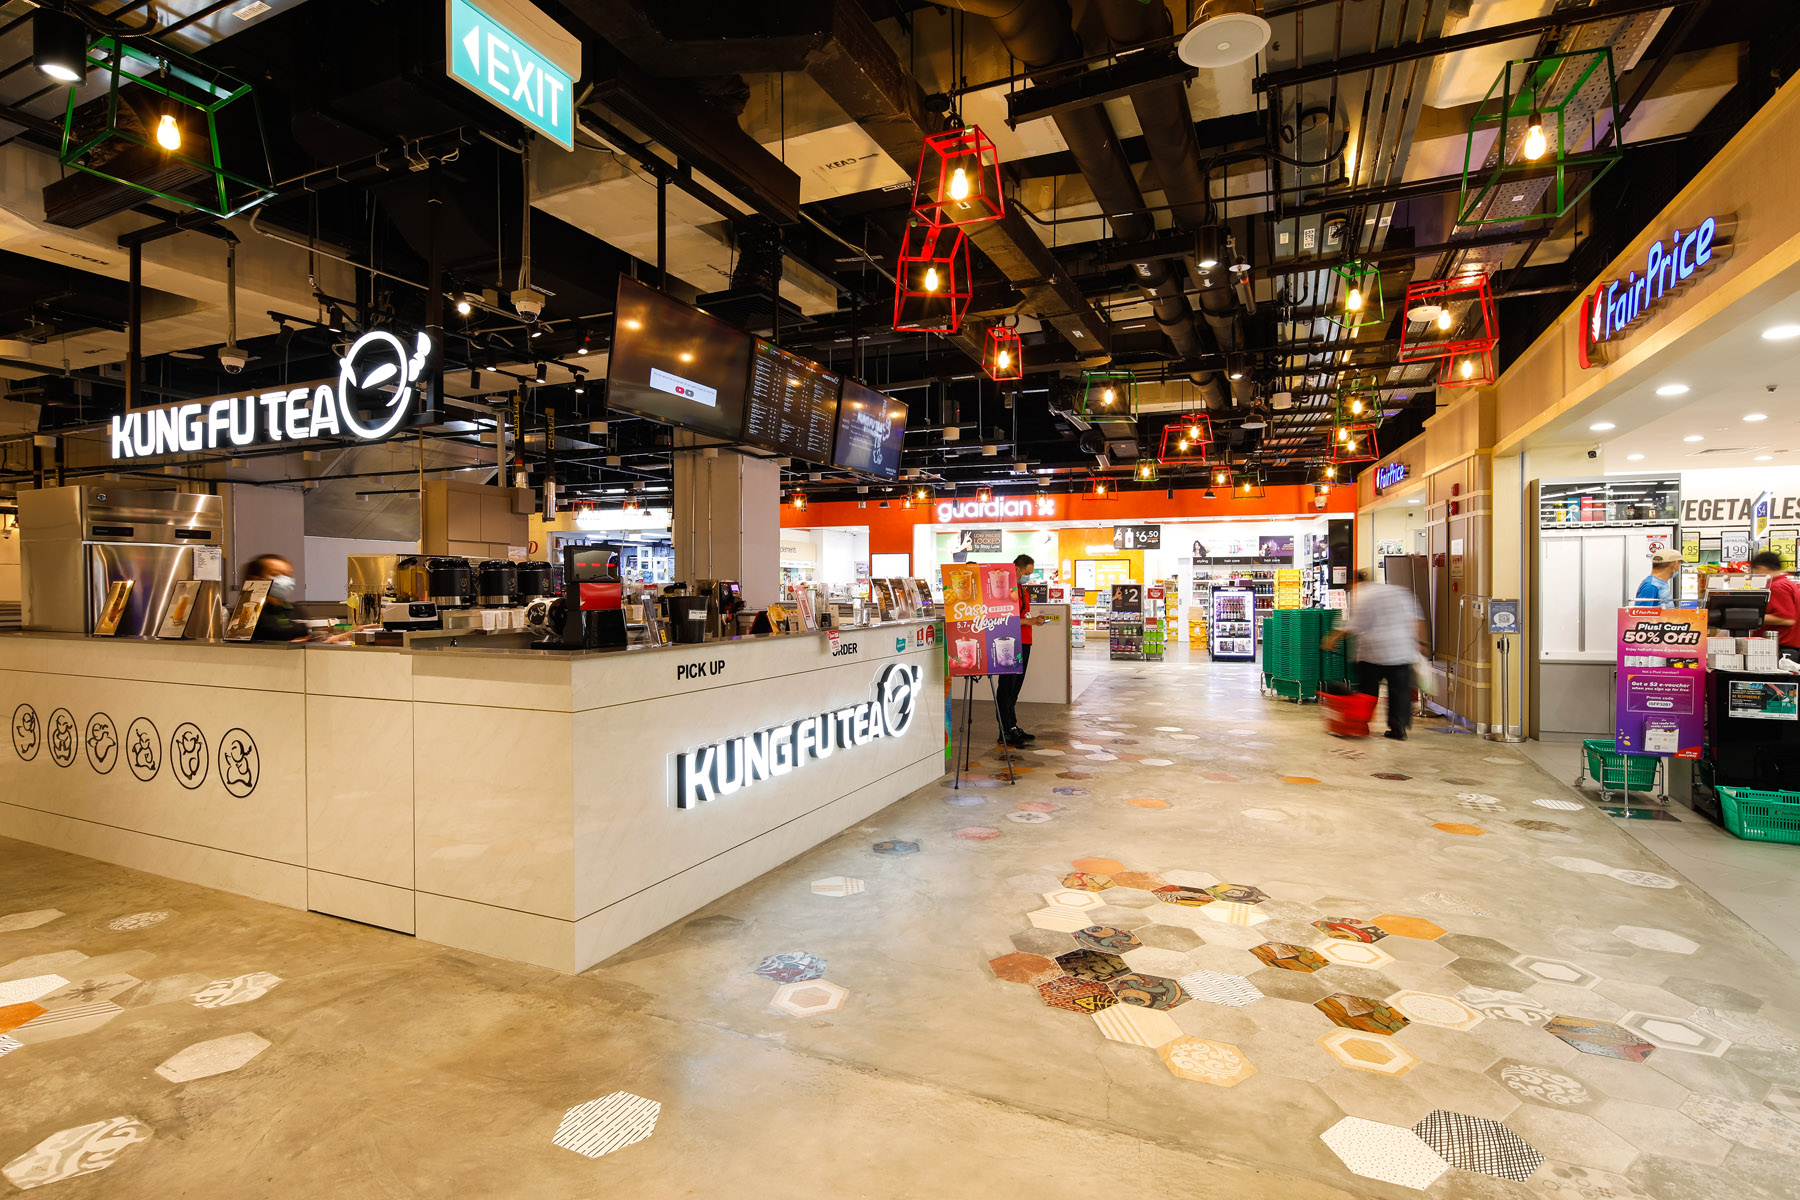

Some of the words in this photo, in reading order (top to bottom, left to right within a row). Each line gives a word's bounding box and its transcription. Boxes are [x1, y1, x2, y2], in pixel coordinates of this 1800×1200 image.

[488, 32, 564, 127] EXIT
[1605, 216, 1716, 341] FairPrice
[111, 403, 203, 460] KUNG
[208, 396, 256, 449] FU
[260, 384, 340, 442] TEA
[1379, 462, 1406, 490] FairPrice
[937, 496, 1032, 523] guardian
[1135, 530, 1159, 543] $6.50
[1723, 545, 1747, 559] 1.90
[1124, 588, 1139, 603] $2
[953, 601, 988, 620] Sasa
[971, 612, 1014, 634] Yogurt
[1637, 623, 1662, 631] Plus!
[1624, 631, 1660, 643] 50%
[1663, 632, 1699, 644] Off!
[677, 661, 707, 680] PICK
[709, 659, 726, 676] UP
[677, 726, 793, 810] KUNG
[793, 711, 836, 768] FU
[837, 700, 885, 750] TEA
